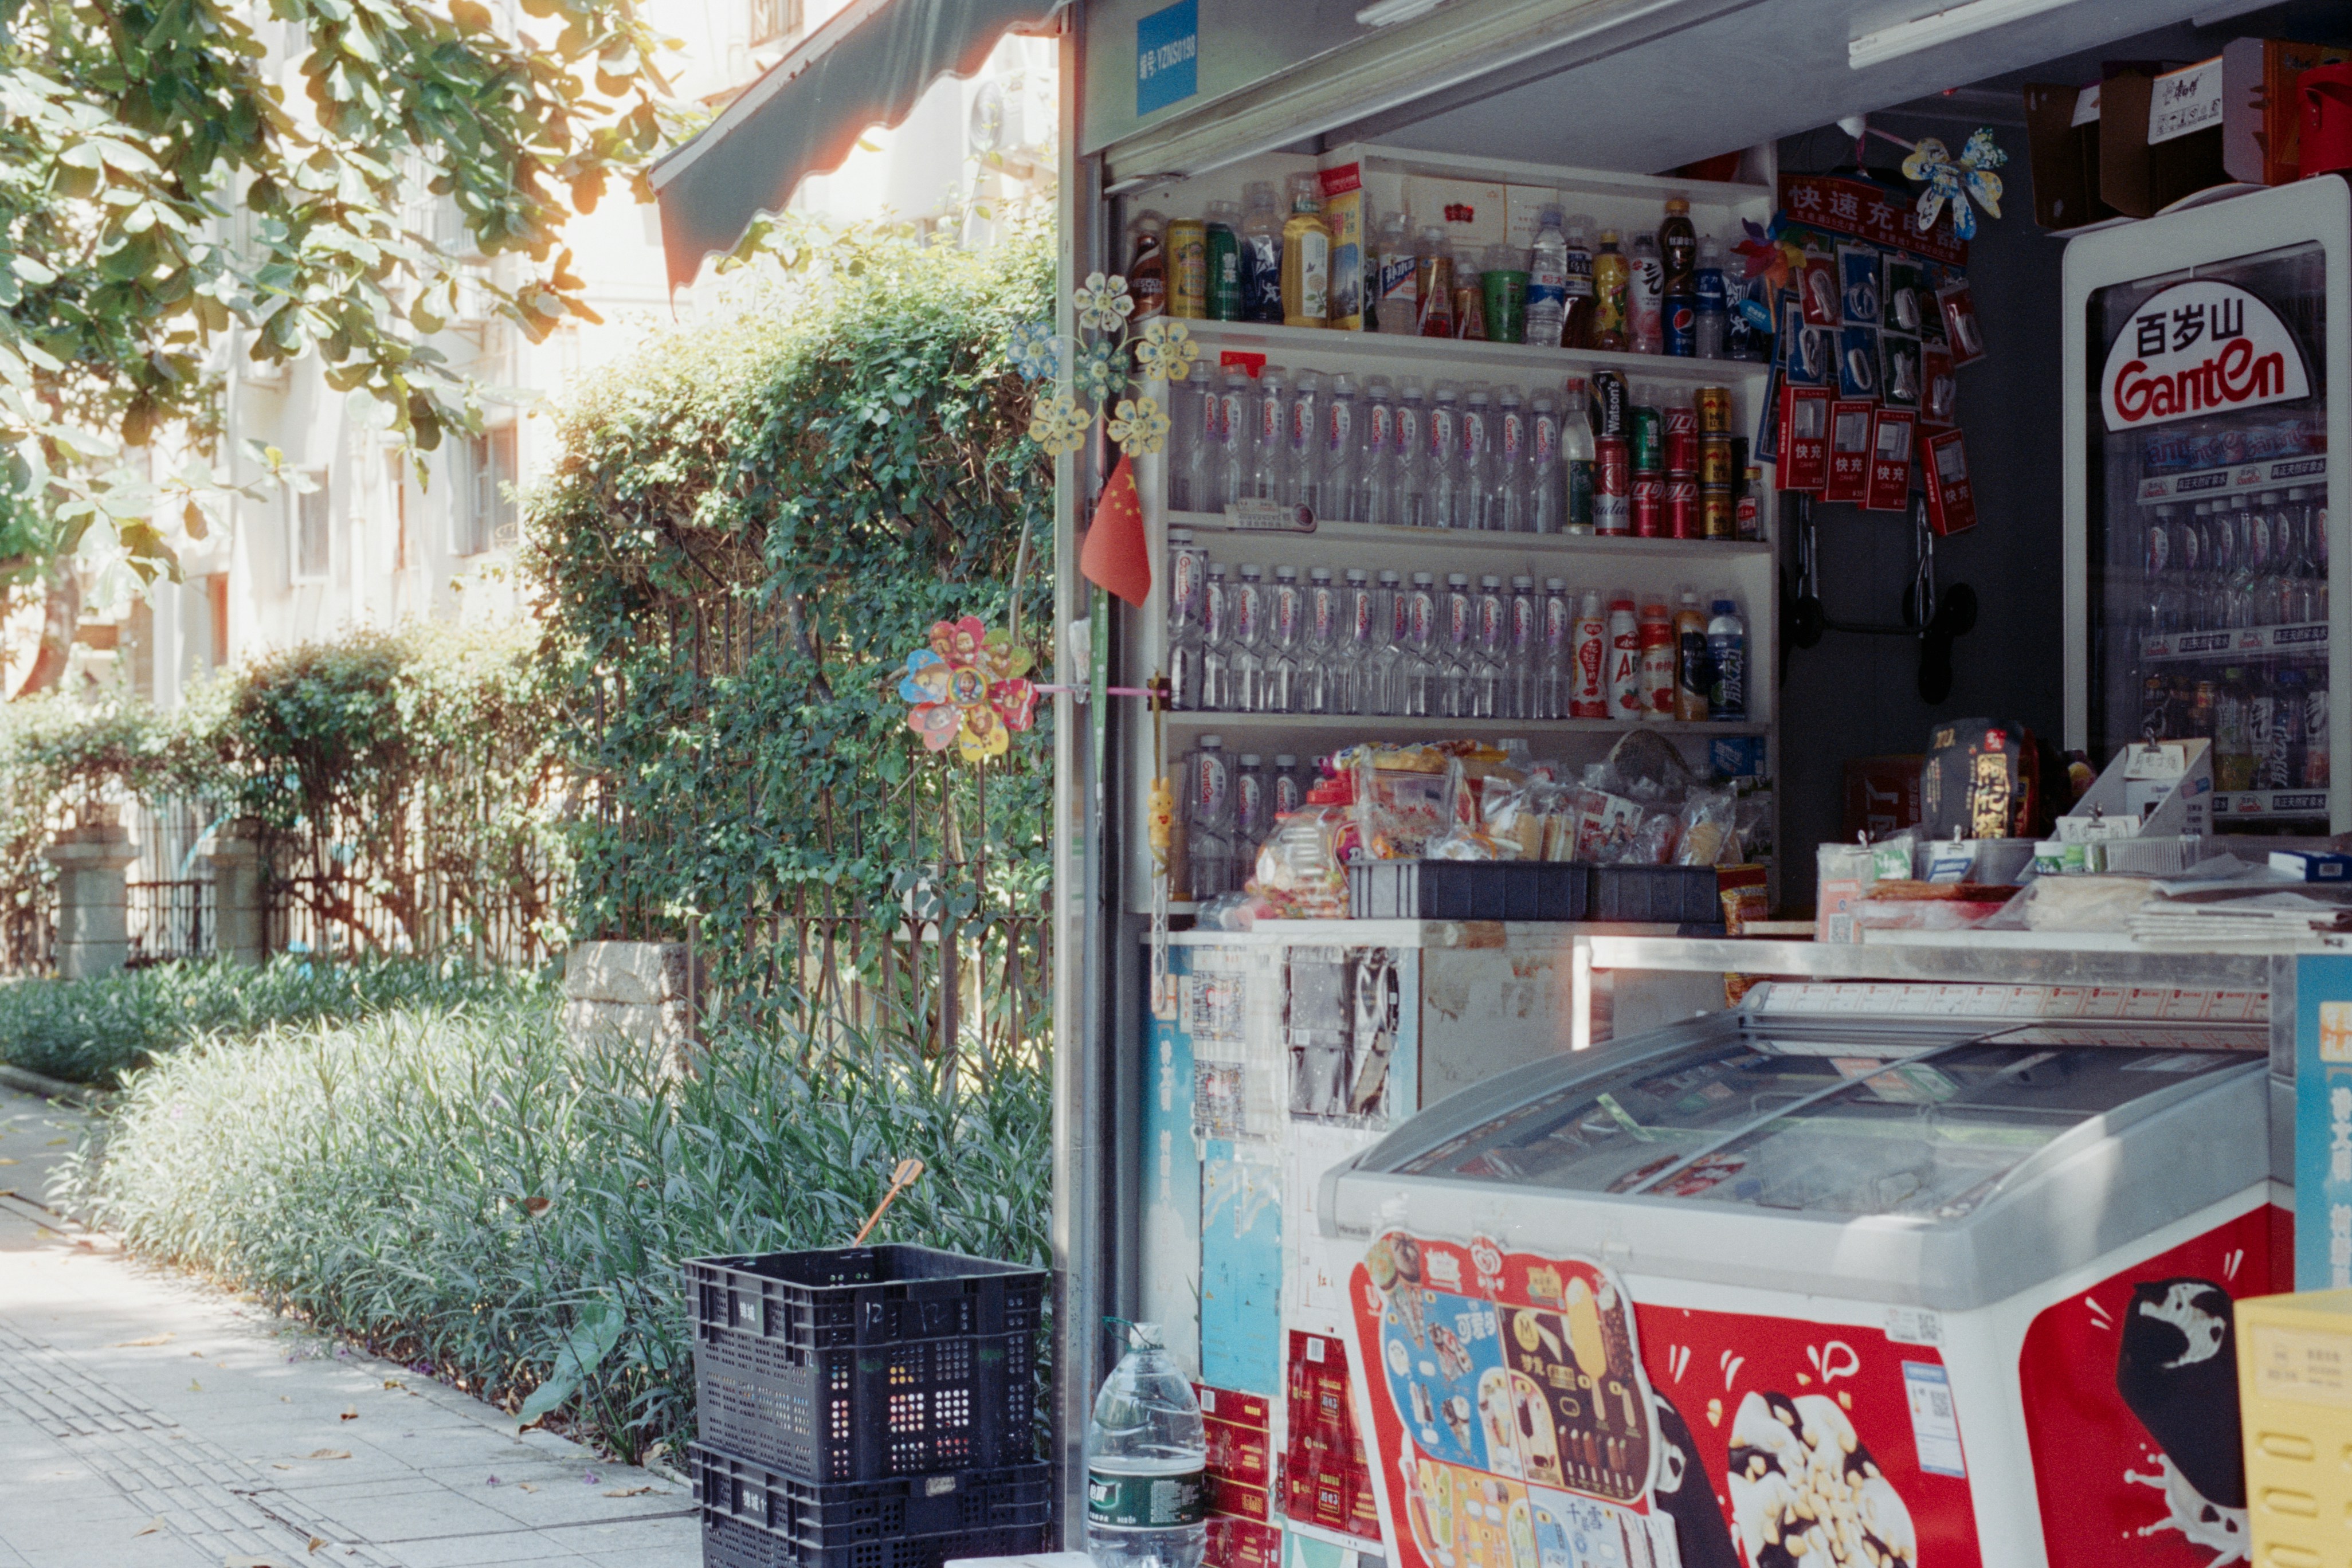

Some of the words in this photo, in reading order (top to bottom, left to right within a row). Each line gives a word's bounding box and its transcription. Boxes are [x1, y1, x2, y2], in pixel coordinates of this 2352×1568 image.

[1787, 184, 1966, 256] 快速充电器
[2137, 298, 2244, 358] 百岁山
[2114, 338, 2284, 422] Ganten
[1606, 381, 1620, 432] Watson's
[1795, 444, 1821, 459] 快充
[1836, 457, 1863, 472] 快充
[1877, 465, 1904, 481] 快充
[1945, 485, 1969, 504] 快充
[865, 1302, 883, 1332] 12
